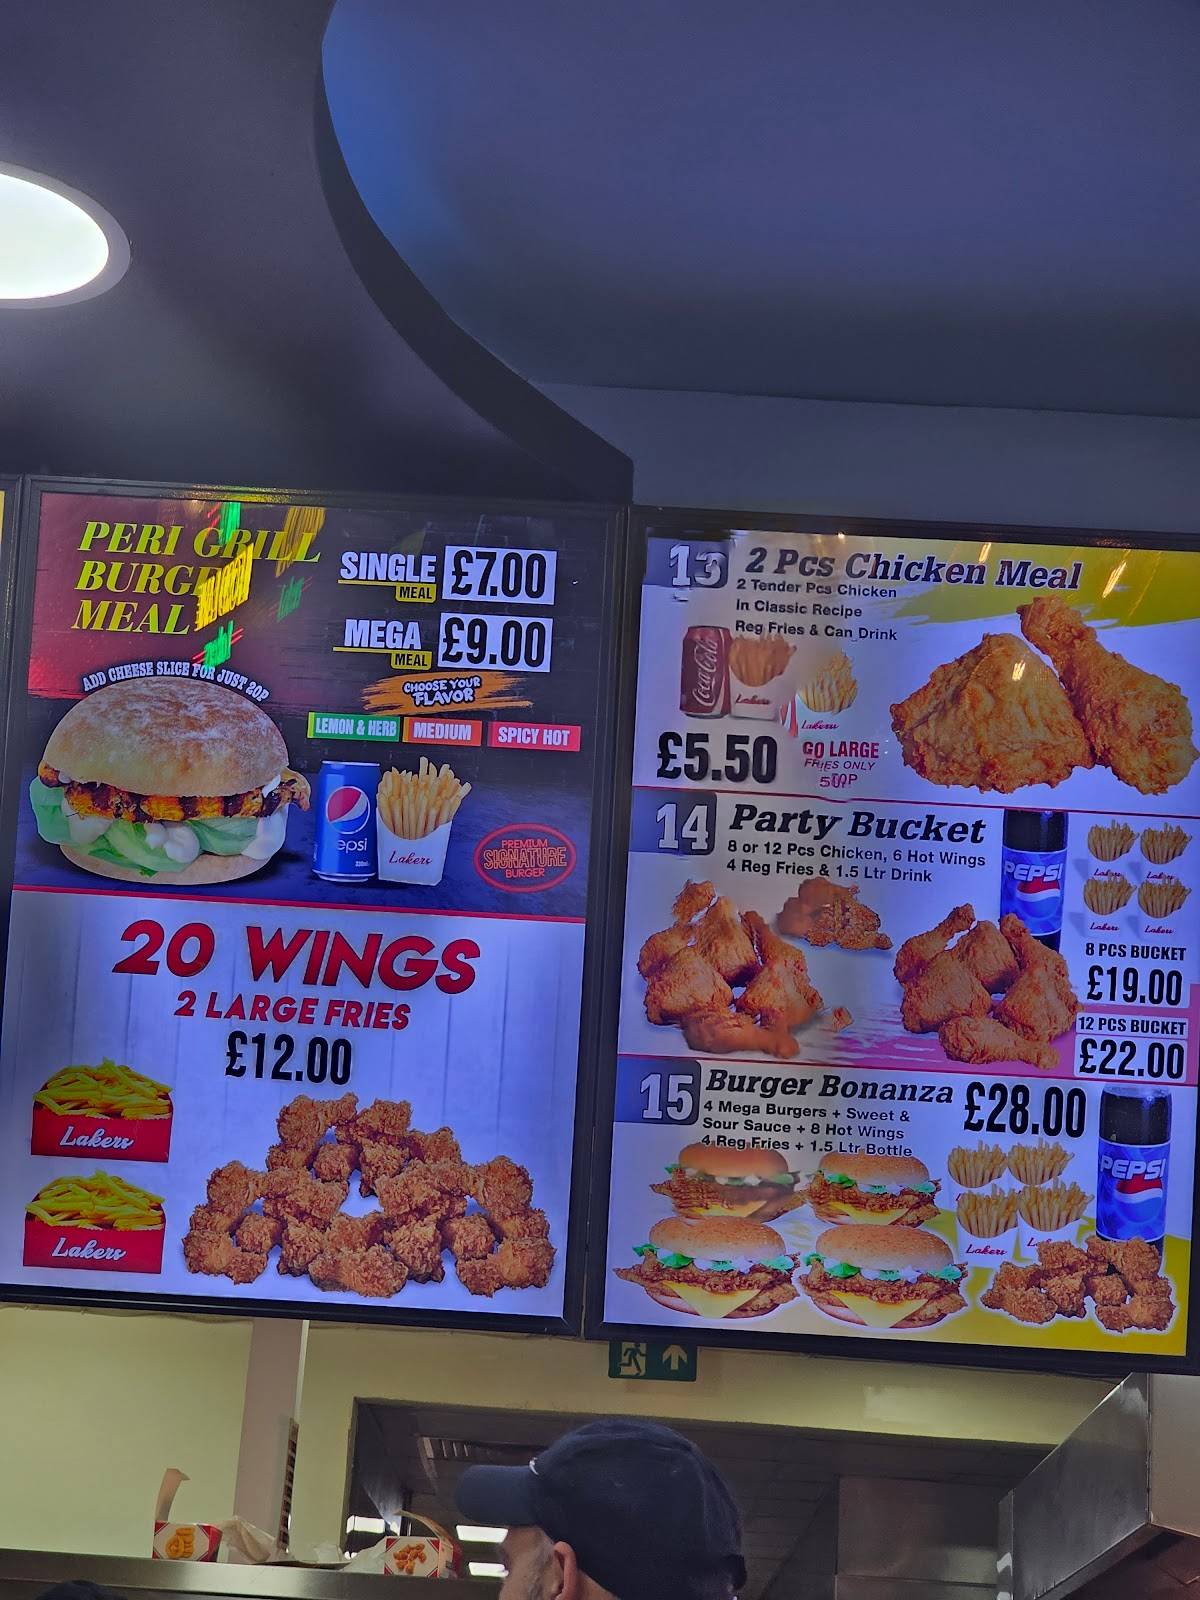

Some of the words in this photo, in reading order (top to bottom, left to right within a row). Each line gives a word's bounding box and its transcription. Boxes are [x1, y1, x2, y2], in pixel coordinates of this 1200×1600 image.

[77, 521, 184, 556] PERI
[193, 527, 320, 563] GRILL
[340, 551, 437, 582] SINGLE
[451, 550, 546, 599] £7.00
[669, 543, 723, 586] 13
[745, 547, 768, 574] 2
[773, 549, 835, 578] Pcs
[845, 552, 987, 585] Chicken
[995, 560, 1082, 589] Meal
[399, 587, 432, 600] MEAL
[736, 578, 747, 590] 2
[750, 580, 800, 593] Tender
[806, 583, 832, 595] Pcs
[837, 584, 897, 598] Chicken
[71, 600, 191, 635] MEAL
[755, 600, 807, 614] Classic
[813, 604, 862, 618] Recipe
[344, 618, 421, 650] MEGA
[441, 616, 546, 668] £9.00
[735, 620, 763, 635] Reg
[768, 622, 804, 636] Fries
[810, 625, 818, 636] &
[824, 626, 852, 639] Can
[859, 628, 897, 641] Drink
[394, 654, 428, 667] MEAL
[82, 670, 106, 692] ADD
[108, 661, 154, 681] CHEESE
[157, 661, 189, 677] SLICE
[192, 663, 215, 680] FOR
[217, 669, 247, 690] JUST
[403, 679, 448, 694] CHOOSE
[449, 676, 481, 690] YOUR
[412, 688, 474, 706] FLAVOR
[316, 717, 354, 735] LEMON
[357, 720, 365, 735] &
[368, 719, 397, 737] HERB
[413, 722, 472, 741] MEDIUM
[498, 726, 539, 744] SPICY
[542, 729, 570, 746] HOT
[657, 732, 777, 784] £5.50
[803, 741, 824, 758] GO
[829, 741, 880, 759] LARGE
[804, 758, 839, 772] FRIES
[843, 761, 875, 771] ONLY
[656, 803, 709, 850] 14
[729, 804, 843, 840] Party
[847, 811, 986, 844] Bucket
[336, 838, 367, 854] epsi
[501, 839, 548, 849] PREMIUM
[728, 840, 737, 853] 8
[742, 843, 759, 854] or
[764, 843, 781, 855] 12
[787, 844, 815, 857] Pcs
[820, 846, 887, 862] Chicken,
[893, 849, 902, 861] 6
[907, 850, 934, 864] Hot
[940, 851, 986, 867] Wings
[483, 846, 567, 869] SIGNATURE
[505, 868, 545, 879] BURGER
[727, 859, 736, 872] 4
[742, 860, 770, 876] Reg
[776, 861, 814, 876] Fries
[819, 865, 830, 877] &
[837, 865, 858, 878] 1.5
[864, 866, 886, 879] Ltr
[891, 868, 932, 882] Drink
[1004, 861, 1064, 881] PEPSI
[112, 919, 215, 977] 20
[246, 925, 481, 994] WINGS
[1086, 943, 1095, 956] 8
[1100, 944, 1127, 960] PCS
[1130, 945, 1186, 961] BUCKET
[1087, 964, 1182, 1006] £19.00
[174, 990, 196, 1016] 2
[205, 991, 319, 1024] LARGE
[324, 1000, 411, 1030] FRIES
[1079, 1016, 1094, 1031] 12
[1098, 1017, 1127, 1032] PCS
[1130, 1020, 1187, 1036] BUCKET
[225, 1030, 352, 1085] £12.00
[1079, 1038, 1185, 1079] £22.00
[640, 1073, 694, 1120] 15
[705, 1069, 814, 1098] Burger
[818, 1075, 953, 1104] Bonanza
[964, 1081, 1087, 1138] £28.00
[703, 1100, 713, 1111] 4
[718, 1100, 760, 1116] Mega
[766, 1103, 827, 1119] Burgers
[832, 1110, 841, 1118] +
[846, 1107, 895, 1121] Sweet
[900, 1110, 911, 1121] &
[702, 1117, 739, 1130] Sour
[743, 1120, 791, 1133] Sauce
[796, 1125, 805, 1133] +
[811, 1123, 820, 1135] 8
[825, 1124, 852, 1136] Hot
[858, 1125, 905, 1140] Wings
[701, 1136, 710, 1146] 4
[716, 1136, 745, 1150] Reg
[751, 1137, 790, 1151] Fries
[795, 1142, 804, 1150] +
[810, 1141, 833, 1152] 1.5
[838, 1142, 860, 1154] Ltr
[866, 1143, 914, 1157] Bottle
[1100, 1154, 1166, 1180] PEPSI
